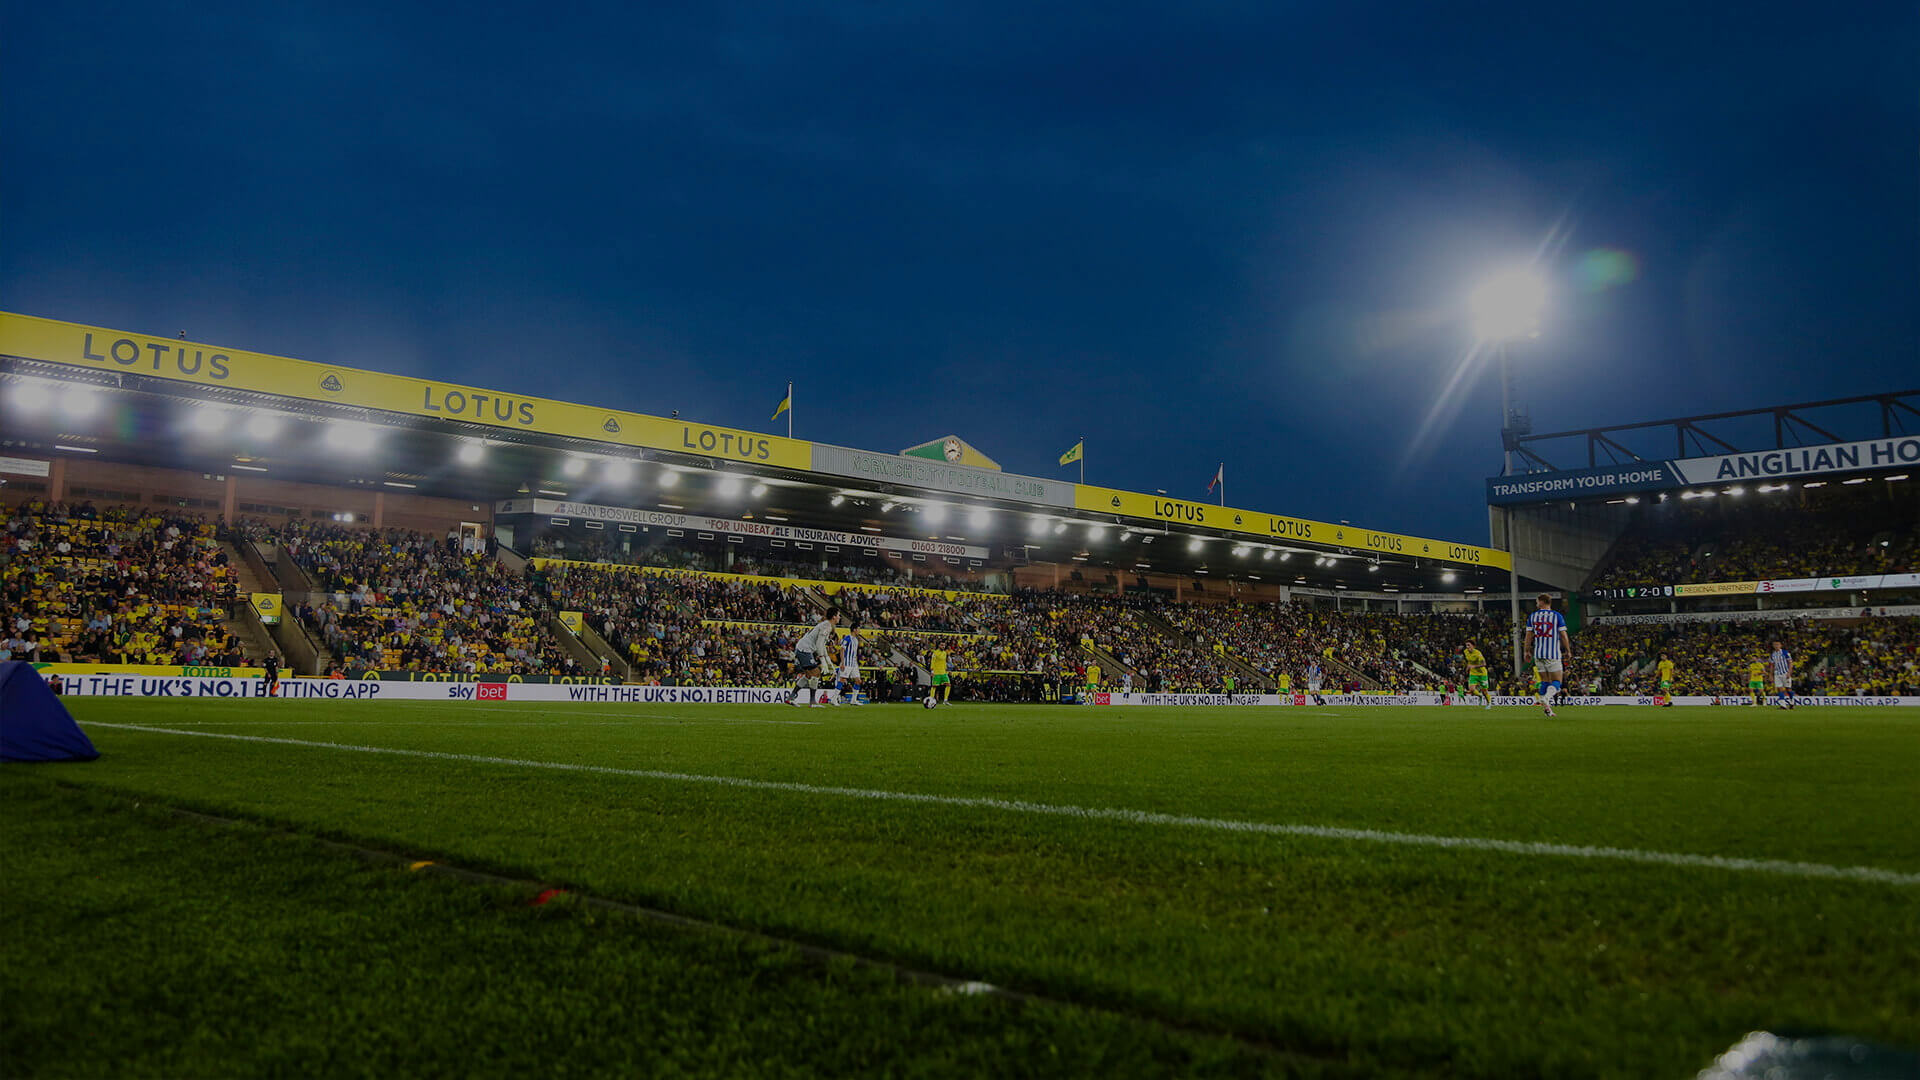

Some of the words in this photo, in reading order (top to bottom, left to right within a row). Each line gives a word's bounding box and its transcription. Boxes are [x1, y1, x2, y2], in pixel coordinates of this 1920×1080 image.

[83, 333, 230, 380] LOTUS
[424, 387, 535, 425] LOTUS
[684, 427, 770, 460] LOTUS
[1717, 445, 1867, 479] ANGLIAN
[1493, 478, 1574, 497] TRANSFORM
[1577, 473, 1615, 488] YOUR
[1619, 469, 1662, 484] HOME
[1155, 500, 1205, 522] LOTUS
[567, 503, 596, 517] ALAN
[600, 505, 647, 522] BOSWELL
[649, 512, 687, 526] GROUP
[794, 528, 846, 543] INSURANCE
[911, 541, 936, 552] 01603
[938, 543, 966, 555] 218000
[1270, 518, 1311, 538] LOTUS
[1367, 533, 1402, 551] LOTUS
[1449, 545, 1481, 562] LOTUS
[1640, 587, 1660, 597] 2-0
[1533, 622, 1554, 638] 32
[89, 678, 135, 695] THE
[141, 679, 193, 697] UK'S
[200, 679, 248, 697] NO.1
[343, 683, 380, 699] APP
[449, 683, 474, 700] sky
[479, 684, 504, 699] bet
[569, 687, 607, 701] WITH
[612, 687, 640, 701] THE
[644, 688, 677, 702] UK'S
[681, 689, 712, 702] NO.1
[717, 690, 771, 703] BETTING
[1141, 695, 1161, 705] WITH
[1163, 695, 1177, 705] THE
[1180, 695, 1197, 705] UK'S
[1498, 697, 1517, 706] UK'S
[1823, 697, 1874, 706] BETTING
[1877, 697, 1900, 706] APP
